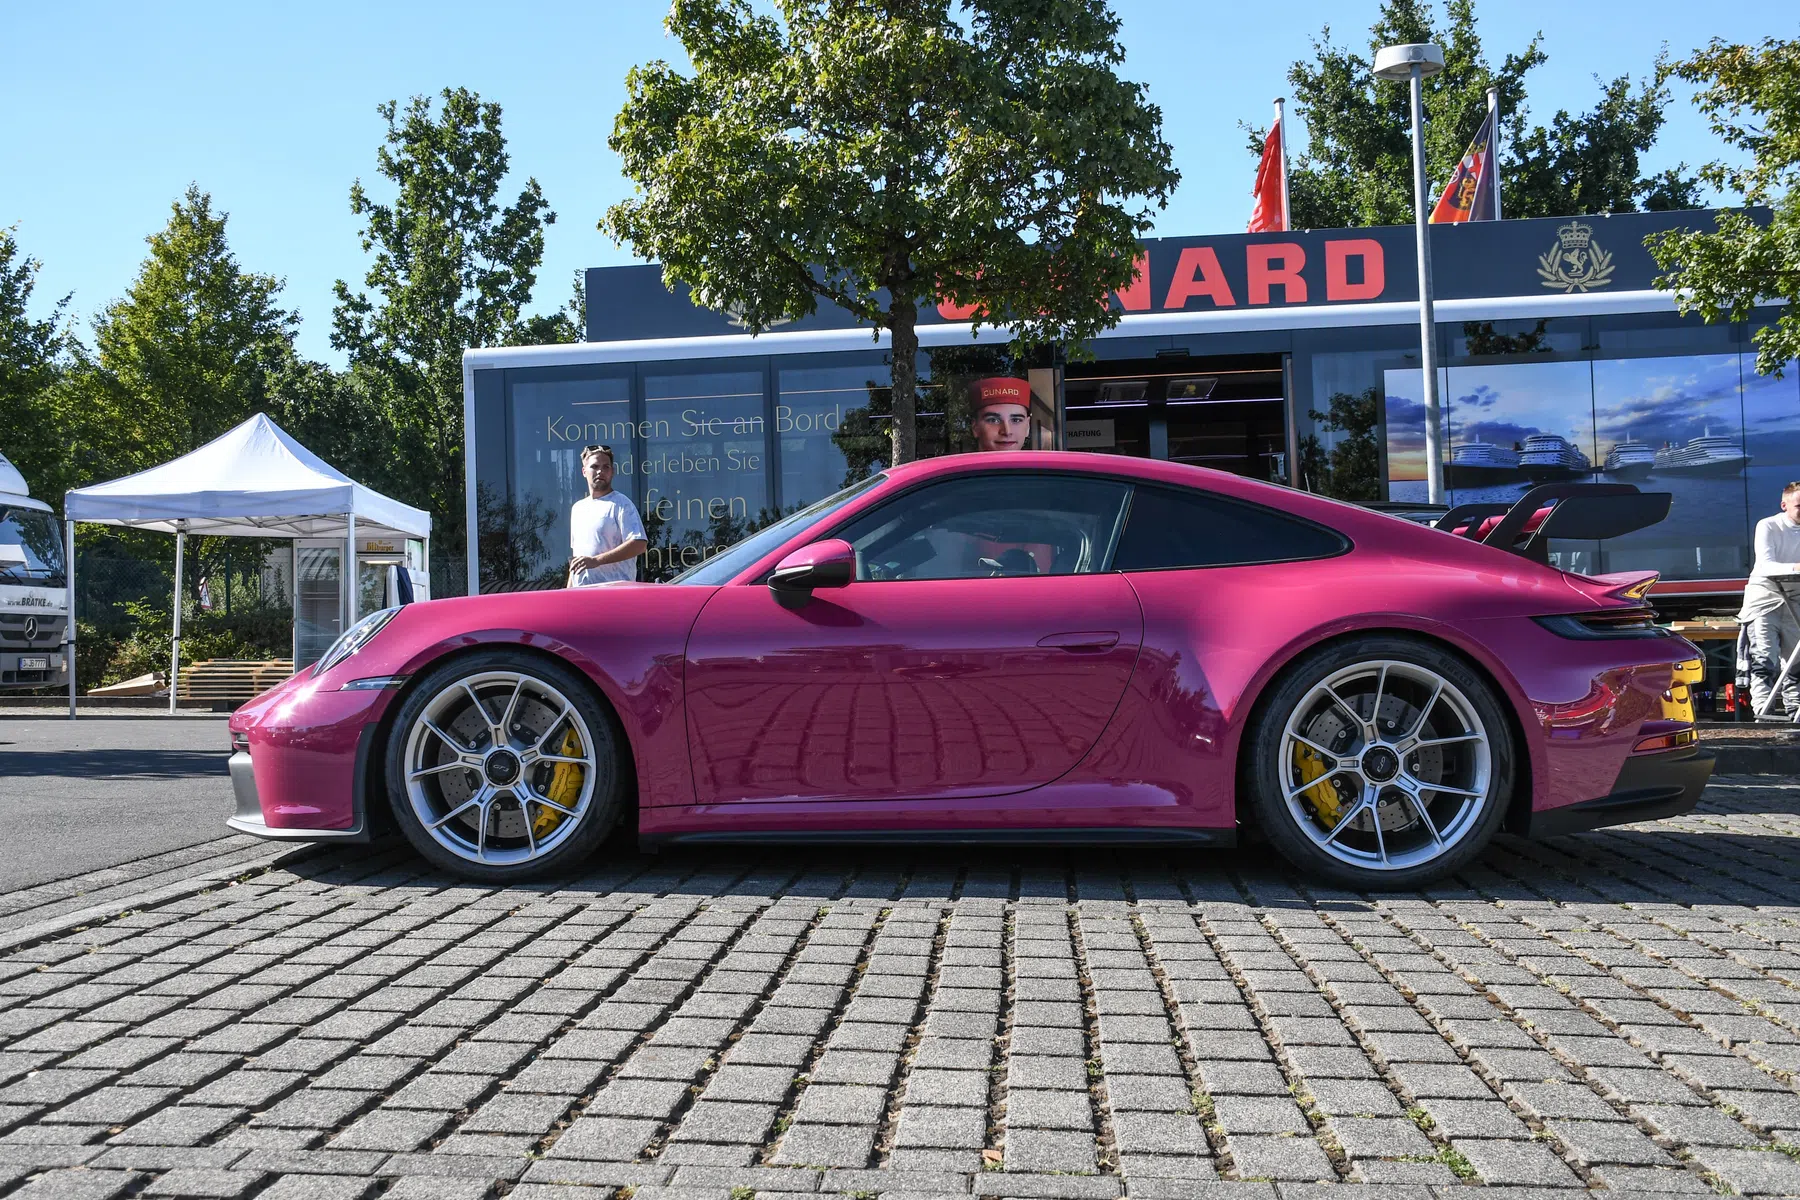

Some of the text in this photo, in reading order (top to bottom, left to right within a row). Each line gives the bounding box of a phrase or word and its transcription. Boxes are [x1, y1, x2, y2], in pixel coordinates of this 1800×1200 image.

[983, 388, 1019, 397] CUNARD
[546, 403, 849, 442] Kommen Sie an Bord.
[1066, 429, 1102, 438] HAFTUNG
[612, 449, 760, 475] nd erleben Sie
[644, 488, 747, 521] feinen
